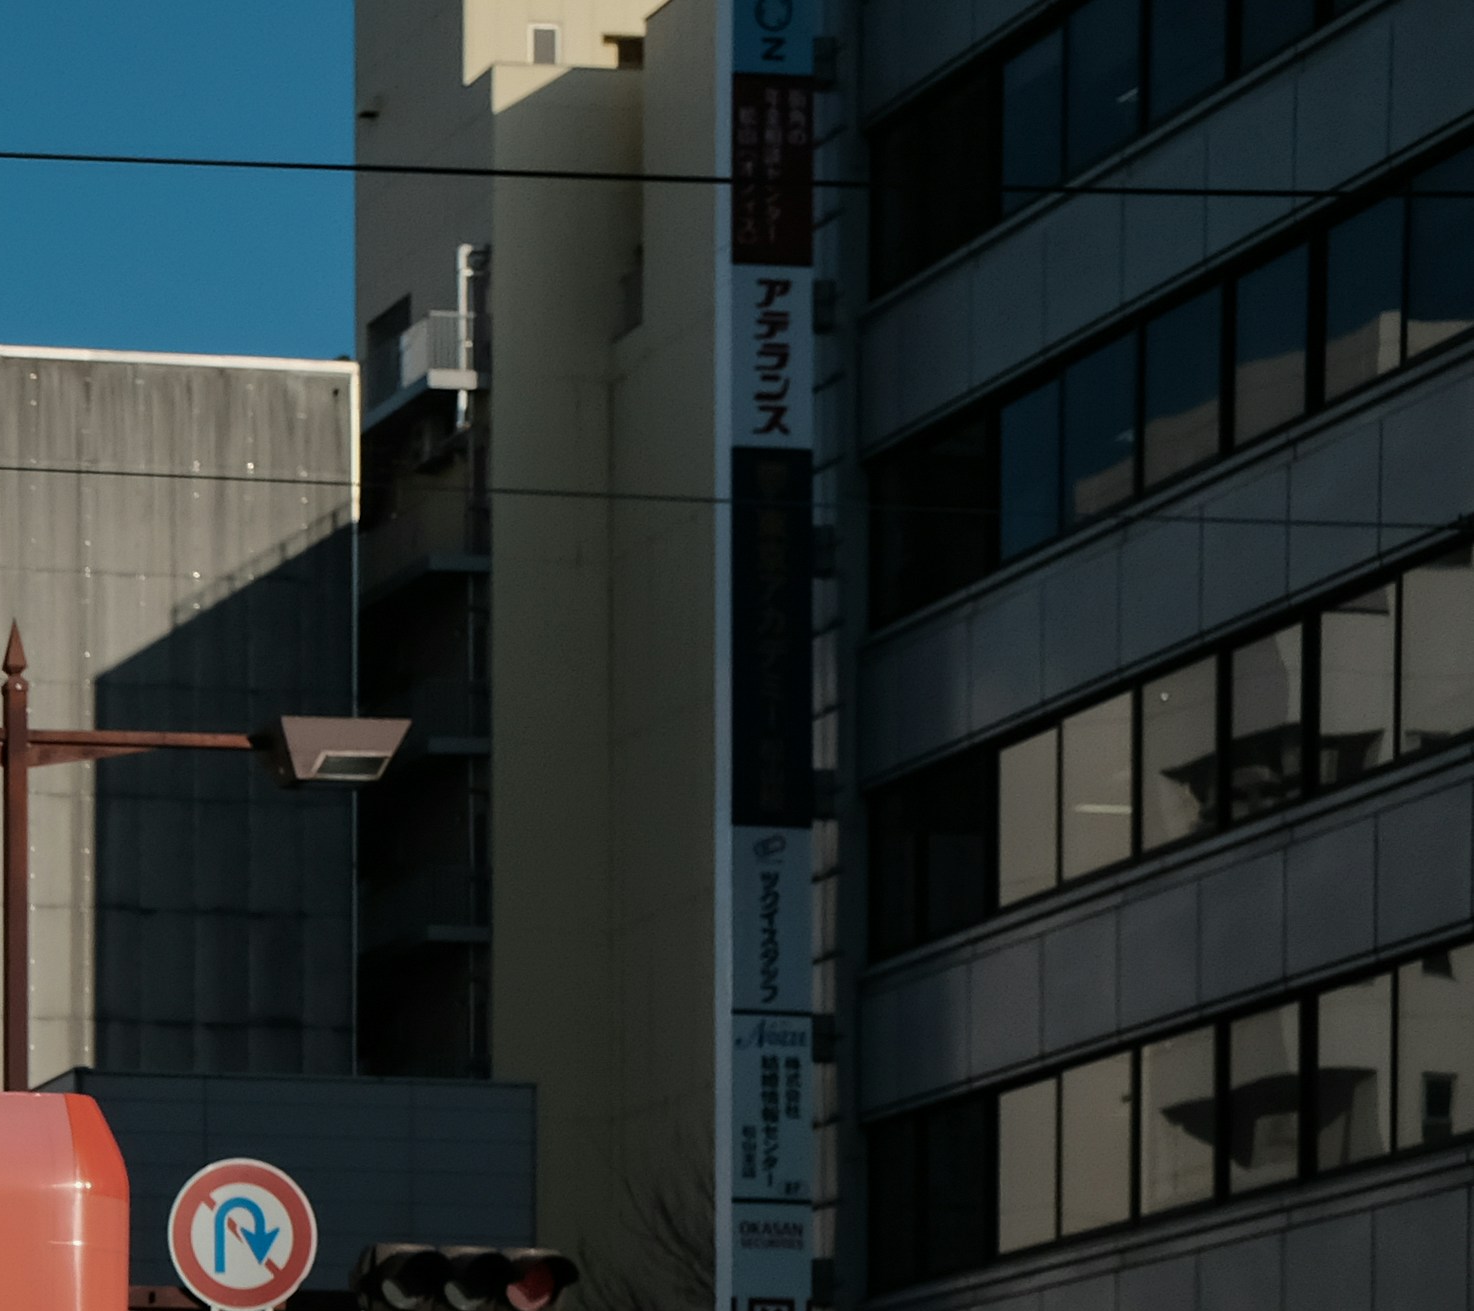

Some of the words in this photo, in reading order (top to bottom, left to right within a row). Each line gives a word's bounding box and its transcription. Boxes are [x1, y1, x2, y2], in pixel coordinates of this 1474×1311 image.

[753, 277, 792, 437] アデランス
[739, 1220, 804, 1237] OKASAN
